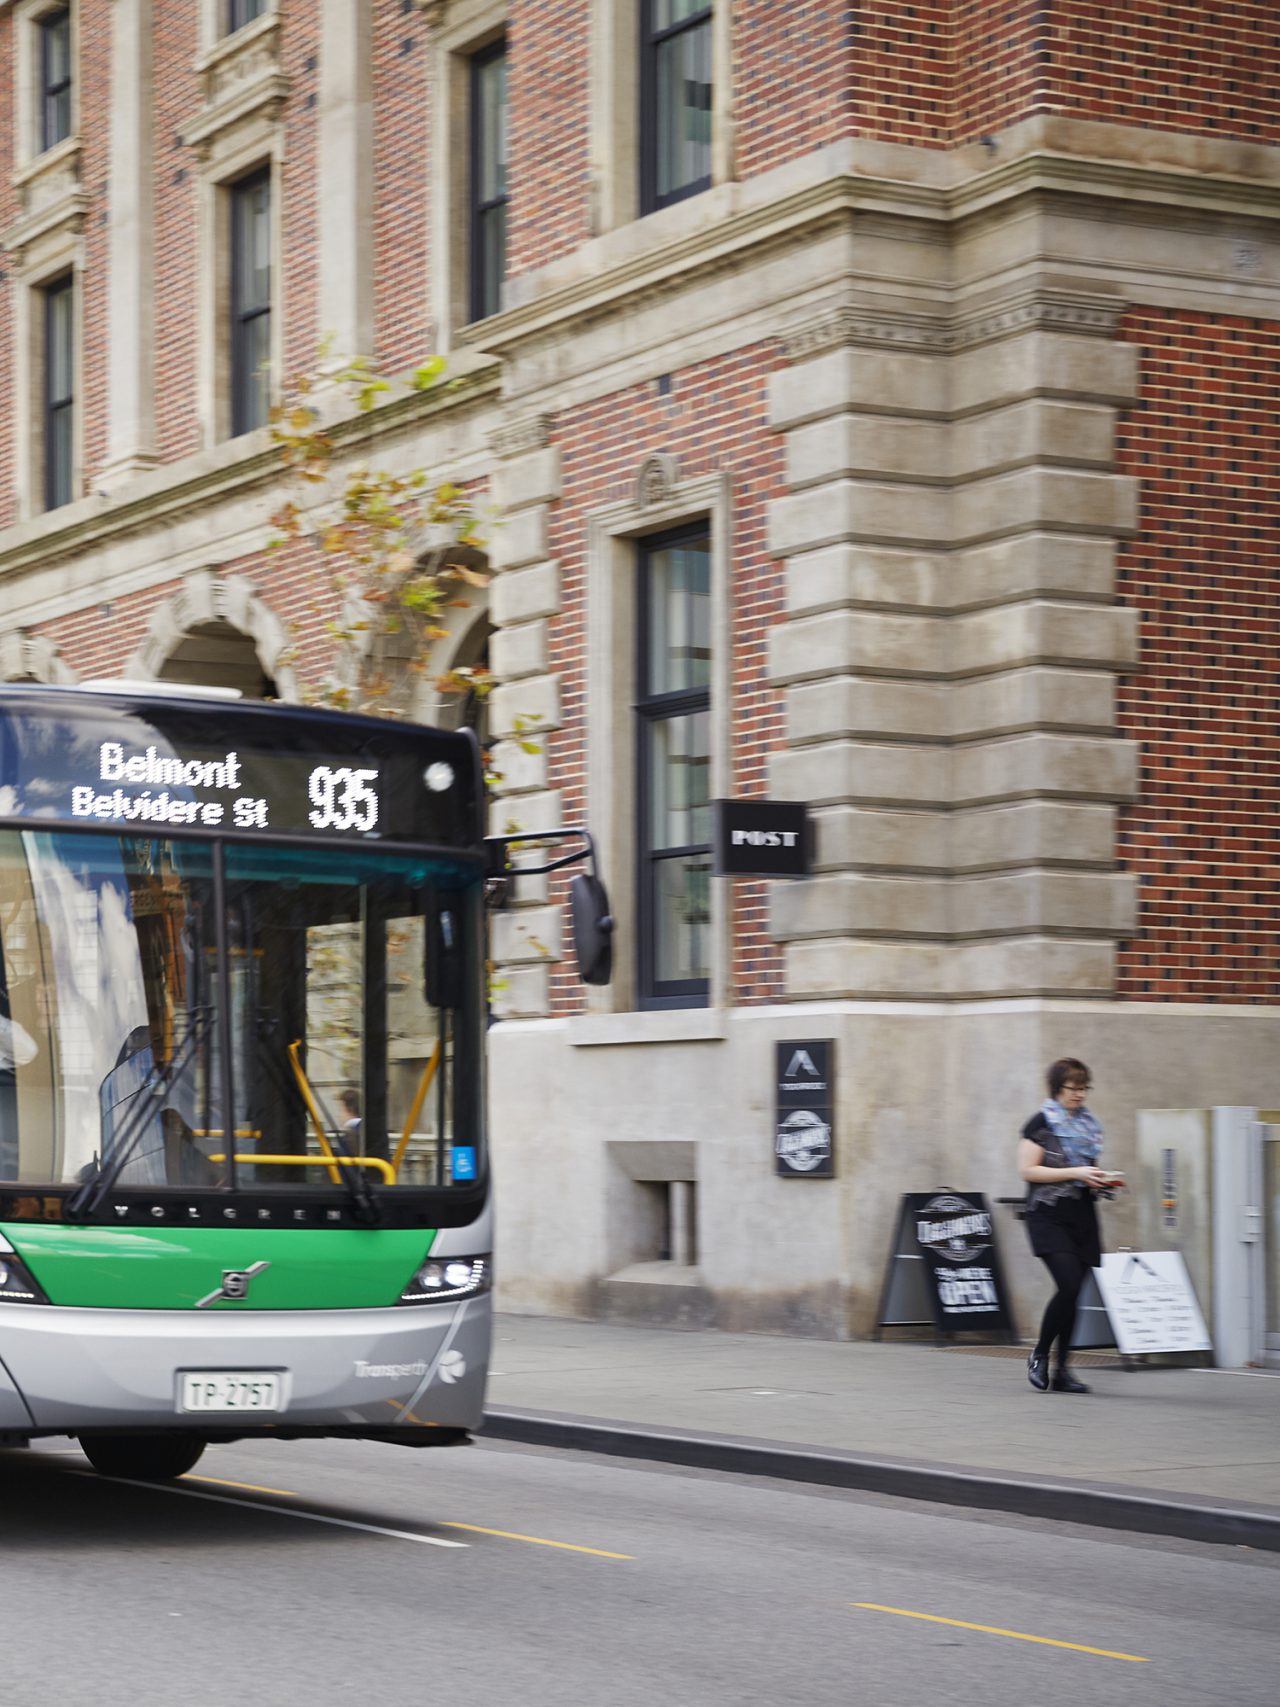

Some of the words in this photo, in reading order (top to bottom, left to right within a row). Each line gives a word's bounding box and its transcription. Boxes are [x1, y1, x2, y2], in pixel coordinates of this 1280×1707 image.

[100, 742, 242, 790] Belmont
[72, 785, 224, 825] Belvidere
[233, 797, 269, 829] St
[308, 766, 379, 831] 935
[731, 830, 799, 847] POST
[114, 1205, 341, 1221] VOLGREN
[354, 1360, 429, 1381] Transperth
[191, 1383, 277, 1407] TP-2757
